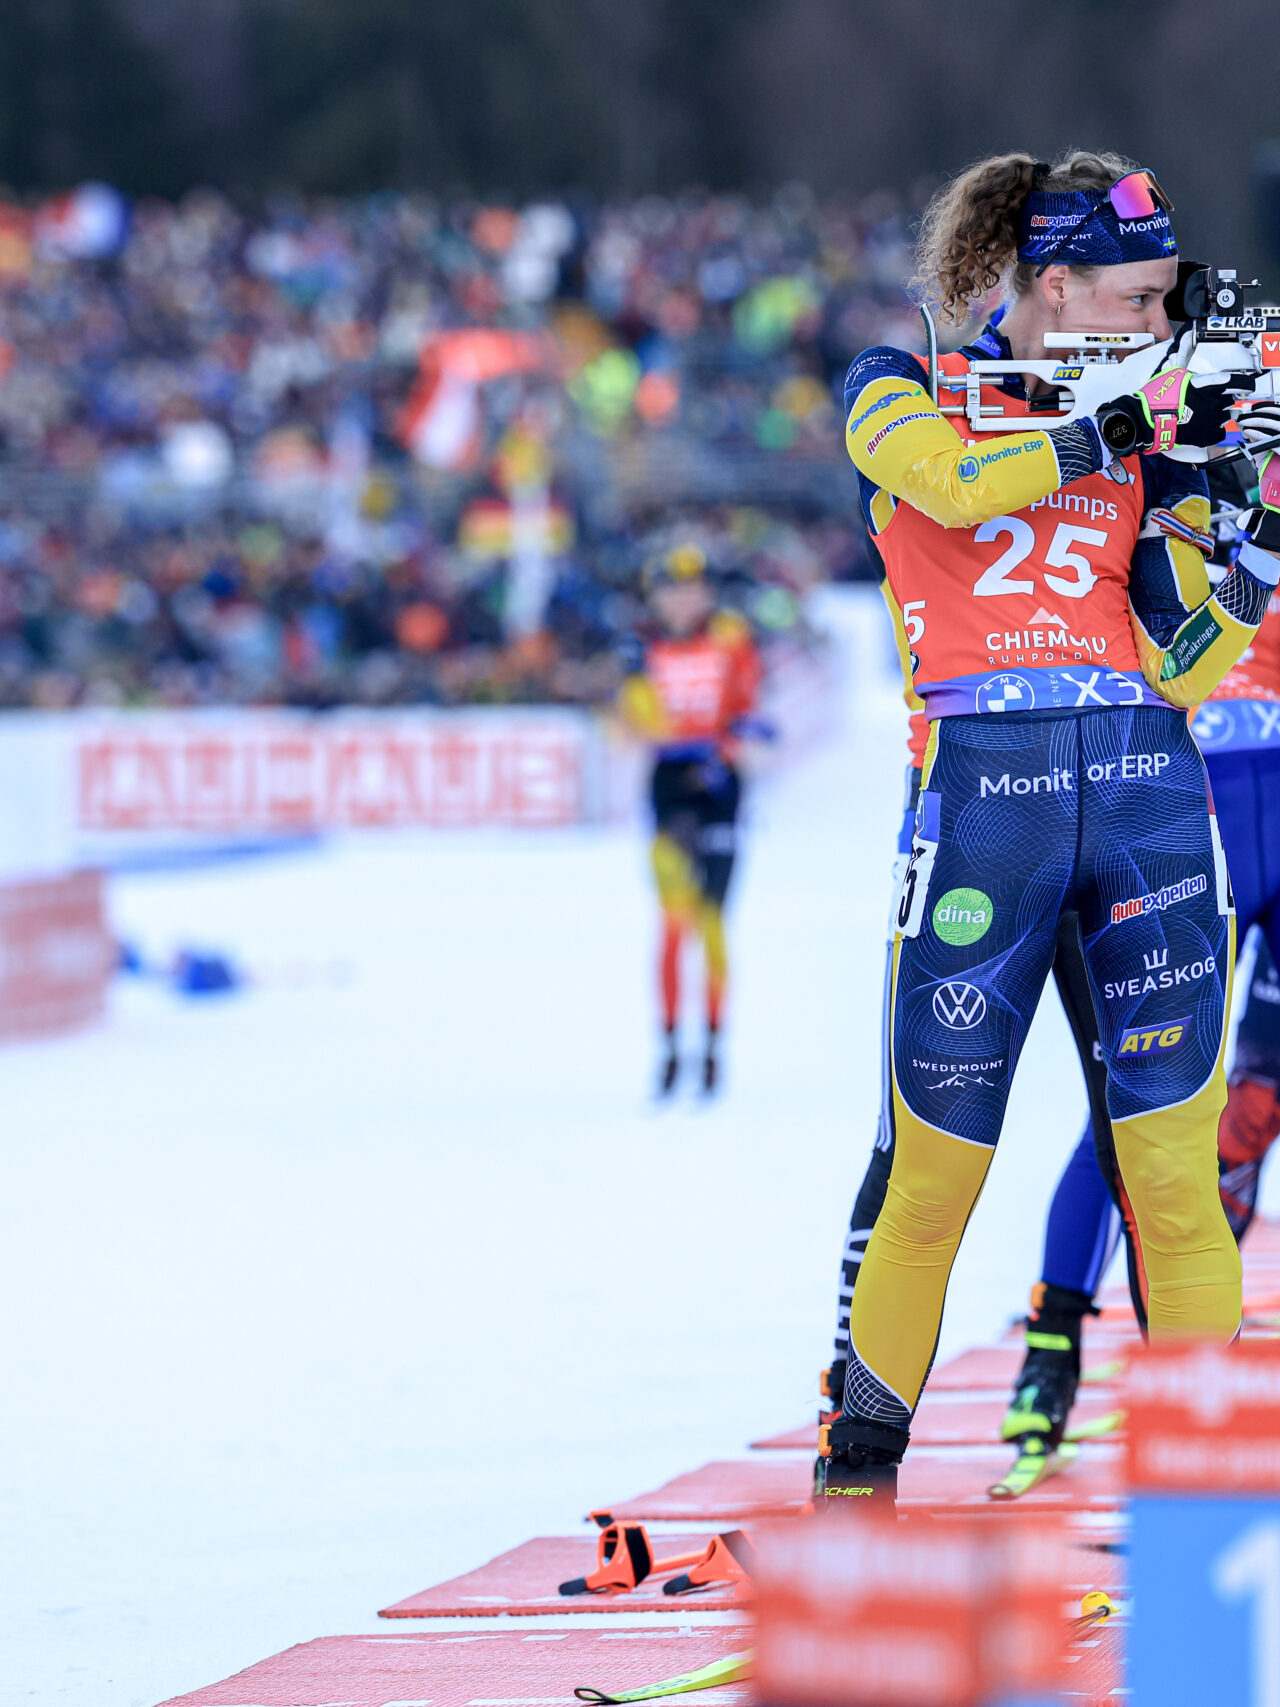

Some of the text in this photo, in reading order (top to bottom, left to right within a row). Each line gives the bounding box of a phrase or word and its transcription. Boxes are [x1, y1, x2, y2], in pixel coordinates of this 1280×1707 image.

[1118, 216, 1170, 235] Monito
[1225, 316, 1264, 329] LKAB
[1054, 367, 1081, 379] ATG
[1153, 369, 1184, 401] LEKI
[866, 412, 941, 457] Autoexperten
[1159, 417, 1172, 451] LEK
[980, 440, 1044, 467] Monitor ERP
[972, 515, 1108, 598] 25
[1060, 672, 1144, 707] X3
[1121, 752, 1170, 779] ERP
[938, 900, 986, 925] dina
[1111, 873, 1207, 924] Autoexperten
[1104, 956, 1216, 1000] SVEASKOG
[1120, 1024, 1184, 1054] ATG
[912, 1059, 1004, 1072] SWEDEMOUNT
[825, 1487, 874, 1496] SCHER
